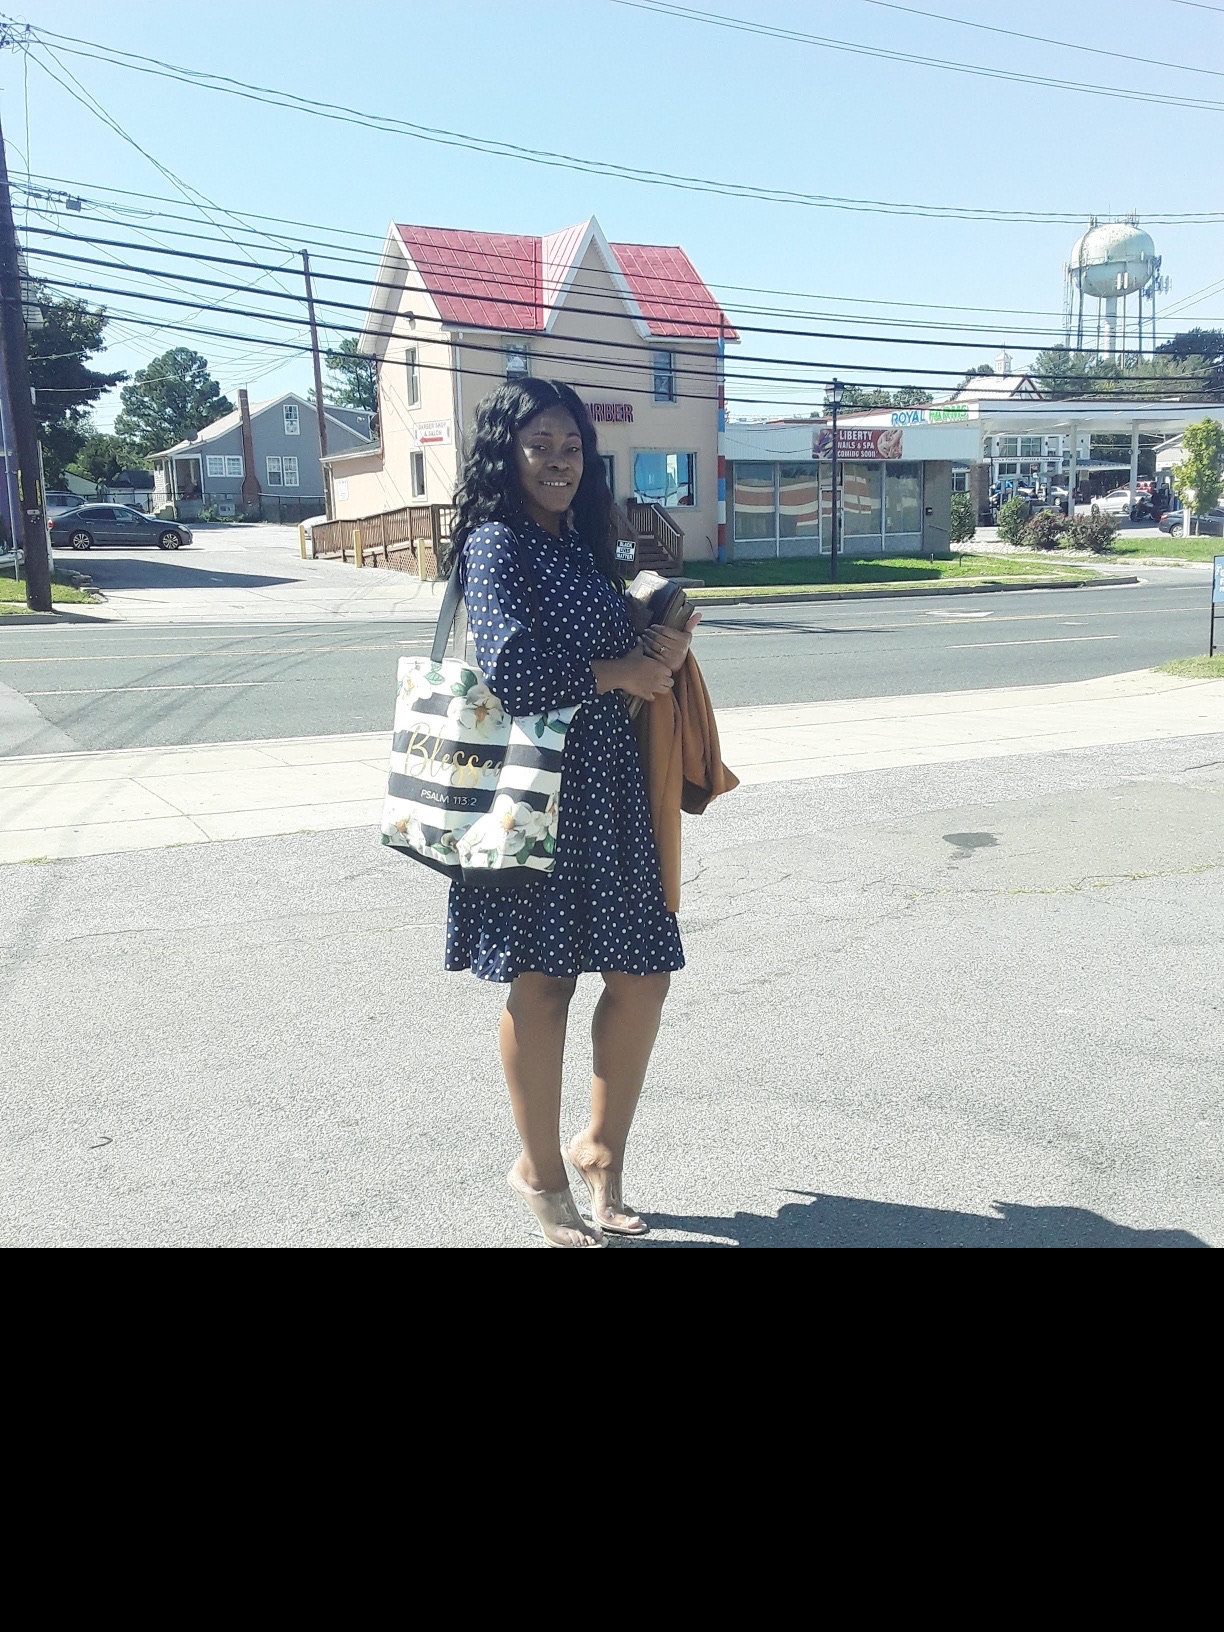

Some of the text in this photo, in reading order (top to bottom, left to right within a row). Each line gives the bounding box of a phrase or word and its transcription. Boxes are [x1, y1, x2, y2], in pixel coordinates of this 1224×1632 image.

[584, 403, 634, 422] ARBER
[891, 404, 969, 425] ROYAL FARMS
[839, 430, 873, 440] LIBERTY
[837, 441, 856, 449] NAILS
[862, 441, 875, 449] SPA
[837, 450, 860, 458] COMING
[421, 789, 477, 806] PSALM 113:2
